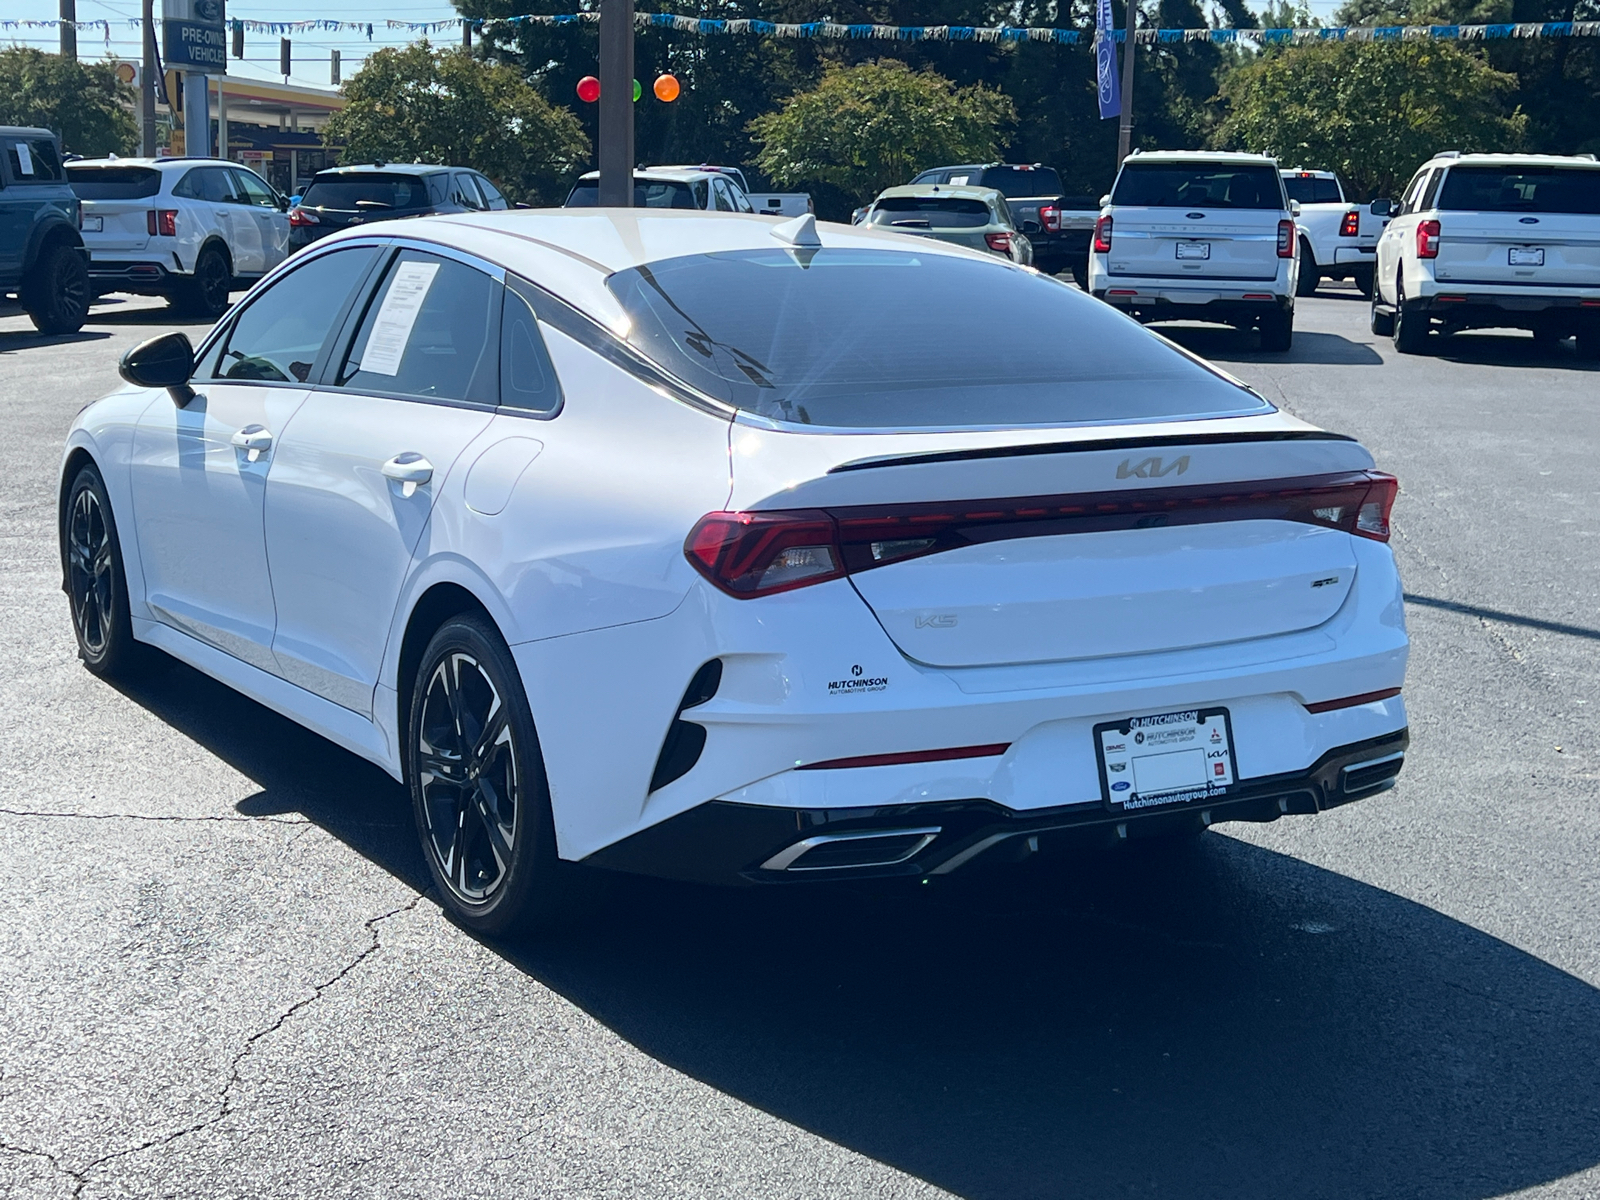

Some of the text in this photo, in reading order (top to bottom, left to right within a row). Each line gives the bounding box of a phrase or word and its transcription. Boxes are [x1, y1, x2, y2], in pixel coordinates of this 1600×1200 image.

[181, 27, 225, 47] PRE-OWNE
[914, 613, 958, 629] K5
[828, 677, 889, 690] HUTCHINSON
[829, 685, 887, 695] AUTOMOTIVE GROUP
[1140, 710, 1198, 728] HUTCHINSON
[1146, 727, 1196, 741] HUTCHINSON
[1105, 743, 1126, 751] GMC
[1123, 786, 1226, 810] Hutchinsonautogroup.com
